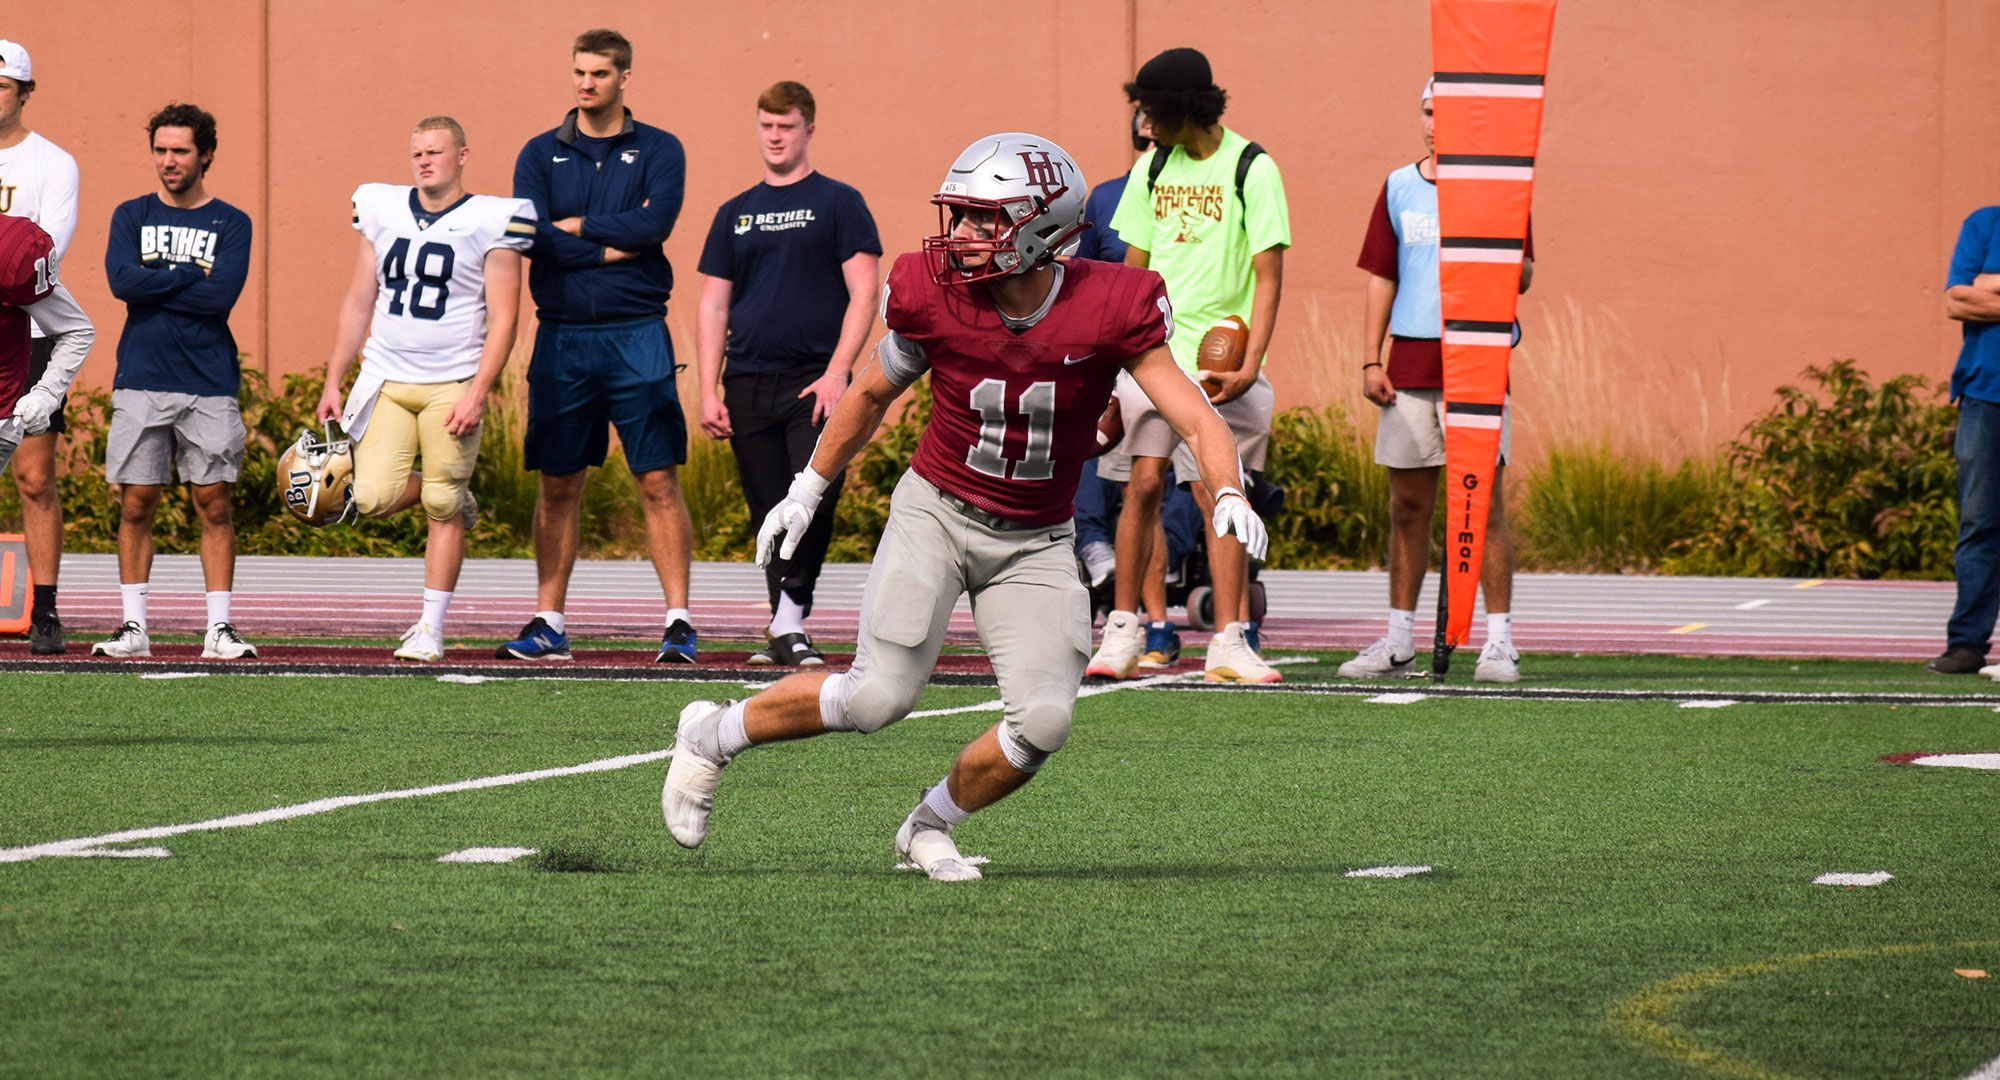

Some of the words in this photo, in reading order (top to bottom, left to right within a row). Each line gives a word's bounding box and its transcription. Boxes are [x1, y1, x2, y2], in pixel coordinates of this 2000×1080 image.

[1016, 151, 1063, 201] HU
[1154, 184, 1224, 196] HAMLINE
[755, 209, 816, 225] BETHEL
[760, 221, 807, 232] UNIVERSITY
[141, 225, 217, 263] BETHEL
[34, 246, 58, 295] 19
[383, 237, 455, 321] 48
[965, 378, 1056, 480] 11
[285, 468, 313, 508] BU
[1459, 474, 1478, 573] Gilman
